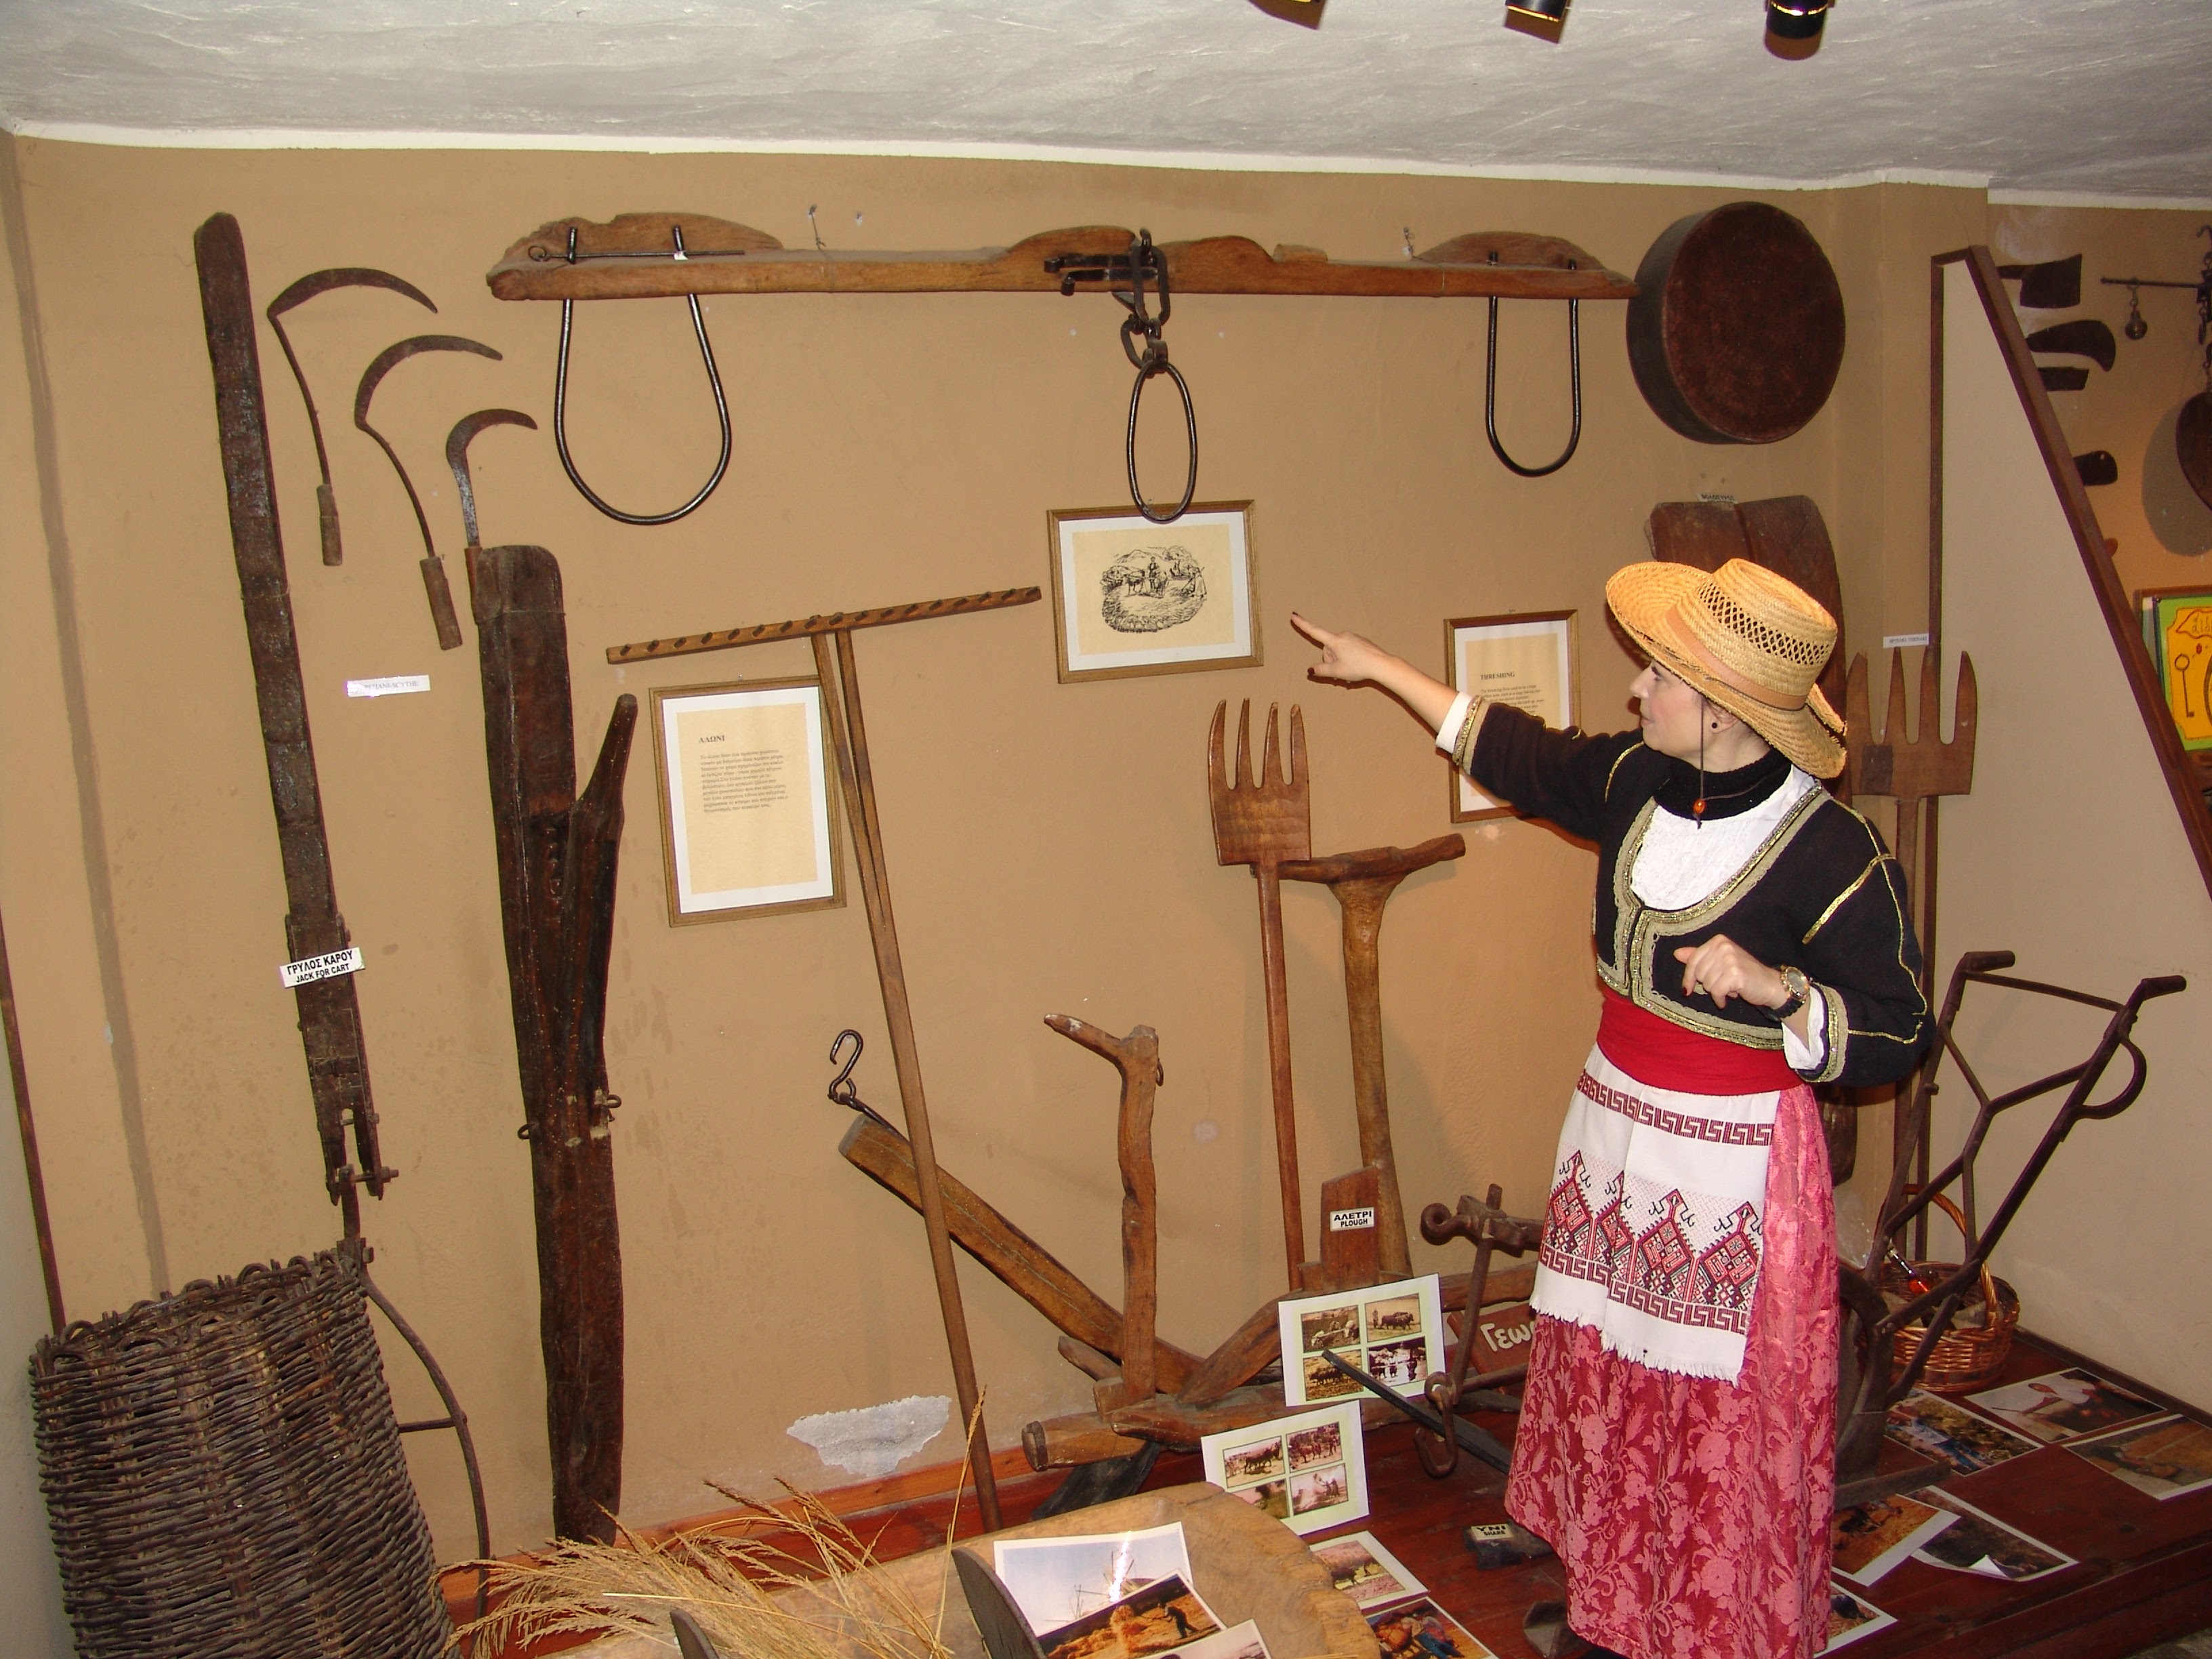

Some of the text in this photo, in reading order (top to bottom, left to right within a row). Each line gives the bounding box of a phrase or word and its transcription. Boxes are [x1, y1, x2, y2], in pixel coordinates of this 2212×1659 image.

[1480, 672, 1515, 680] THRESHING
[287, 950, 352, 975] ΓΡΥΛΟΣ ΚΑΡΟΥ
[296, 963, 350, 983] JACK FOR CART
[1334, 1210, 1372, 1221] ΑΛΕΤΡΙ
[1340, 1218, 1368, 1227] PLOUGH
[1479, 1322, 1536, 1352] Γεω
